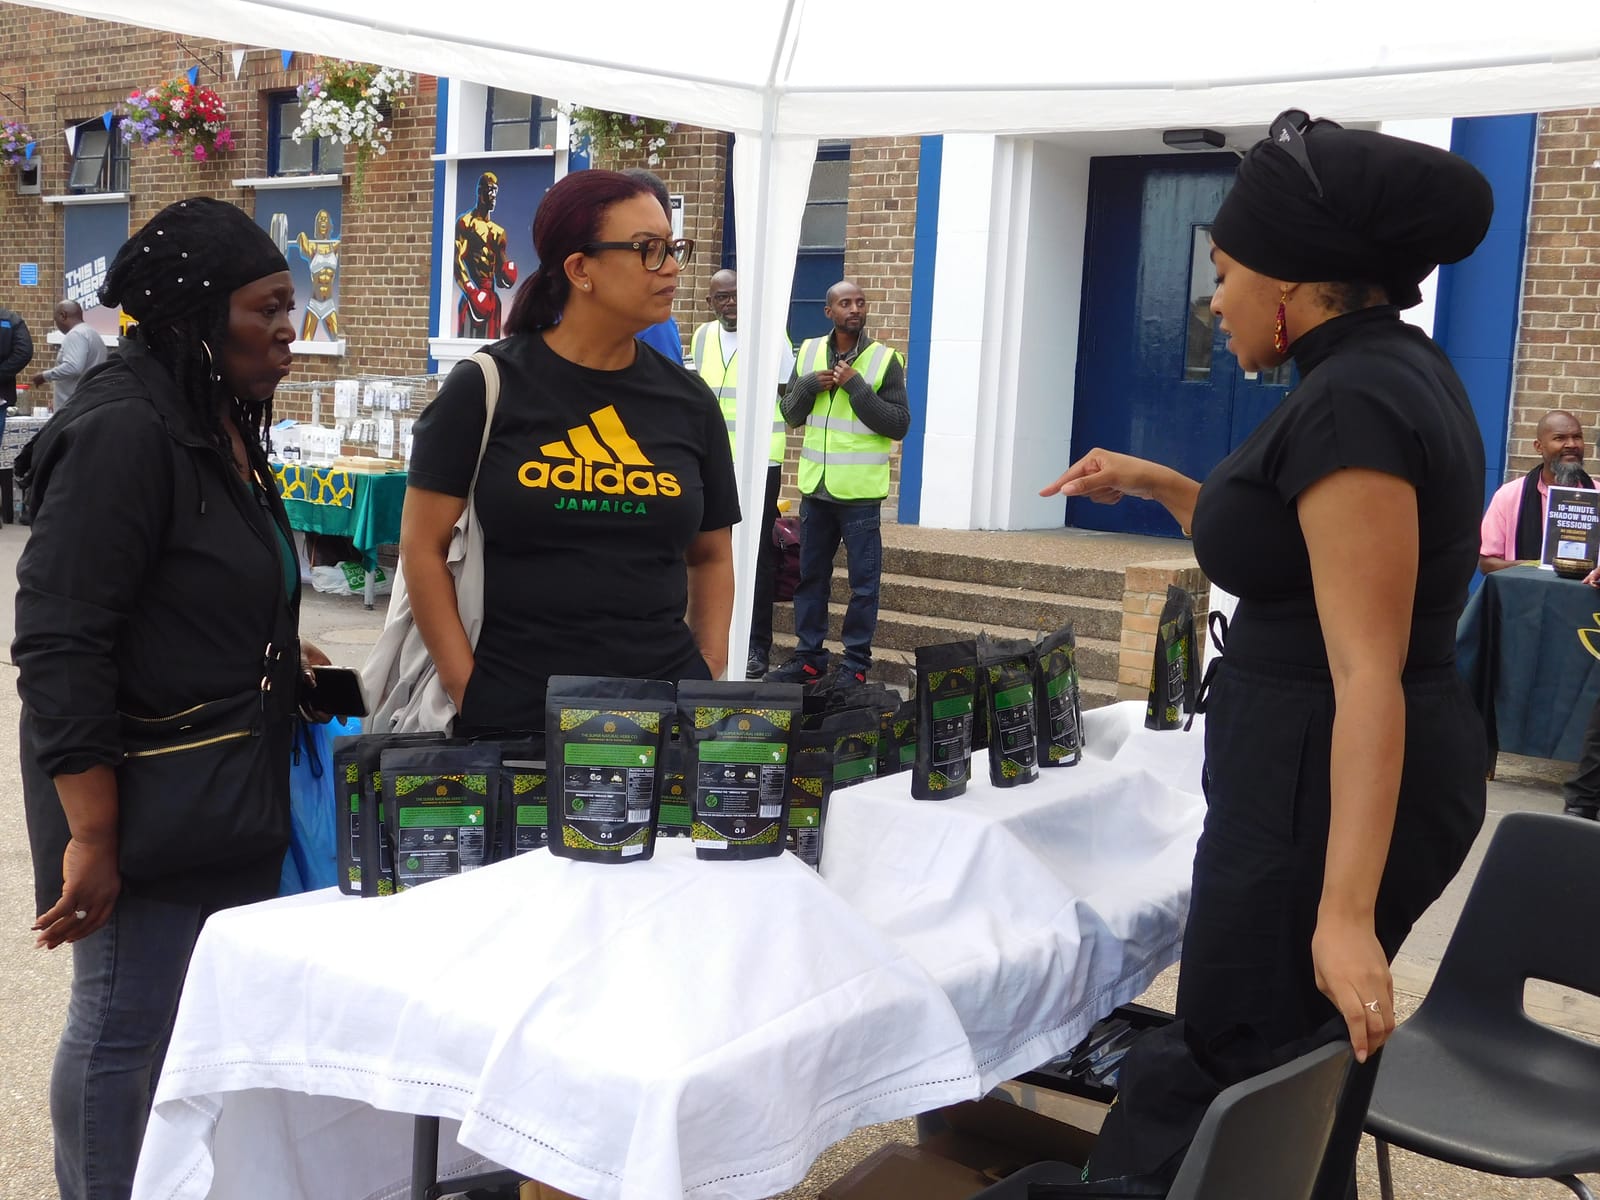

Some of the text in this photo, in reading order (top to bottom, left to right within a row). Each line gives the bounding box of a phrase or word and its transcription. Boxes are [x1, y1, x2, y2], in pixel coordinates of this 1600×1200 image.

[65, 256, 106, 286] THIS IS
[518, 457, 682, 497] adidas
[554, 497, 647, 515] JAMAICA
[1558, 504, 1595, 514] 10-MINUTE
[1549, 511, 1579, 520] SHADOW
[1557, 520, 1592, 530] SESSIONS
